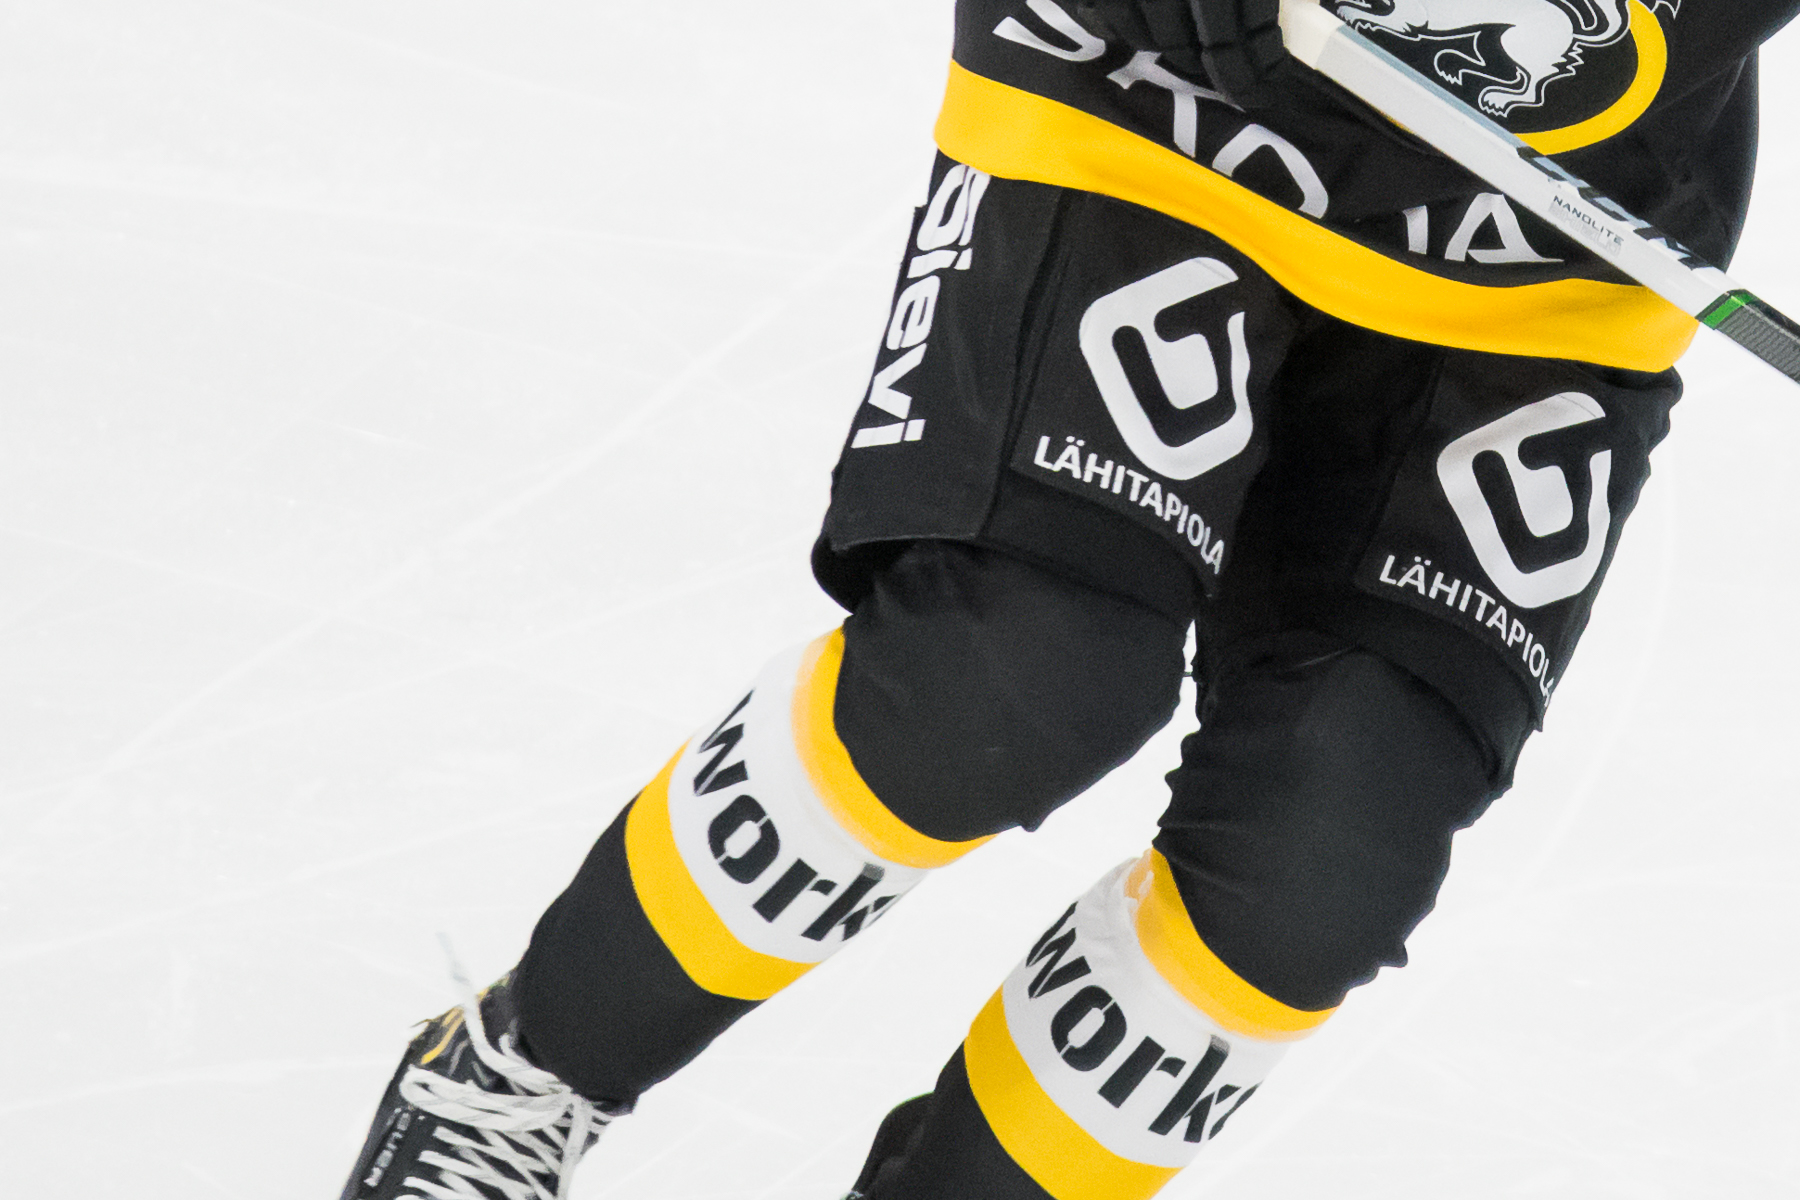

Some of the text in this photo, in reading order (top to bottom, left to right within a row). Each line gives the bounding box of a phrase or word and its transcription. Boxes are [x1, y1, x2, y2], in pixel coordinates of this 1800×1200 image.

[1553, 194, 1625, 246] NANOLITE
[1033, 435, 1225, 575] LÄHITAPIOLA
[692, 687, 904, 943] work
[1025, 900, 1264, 1144] work
